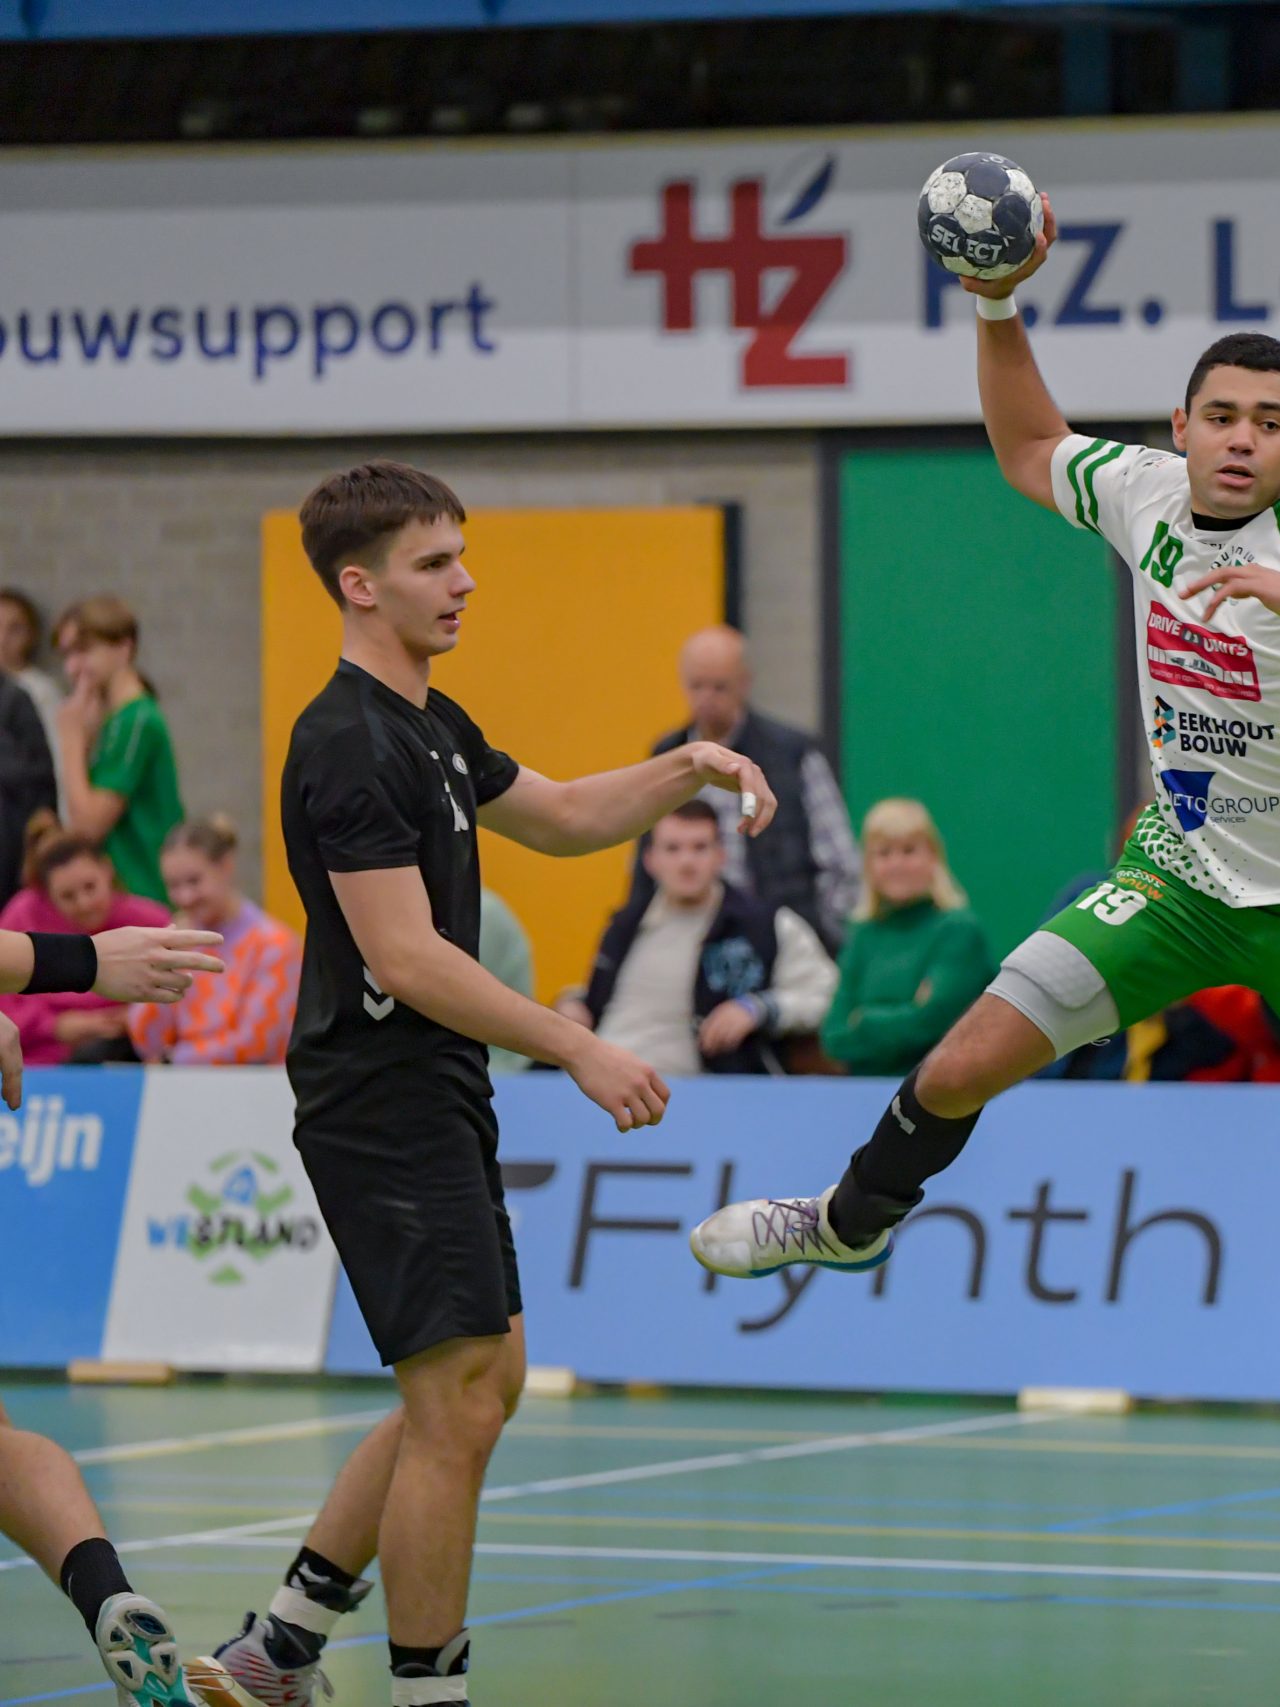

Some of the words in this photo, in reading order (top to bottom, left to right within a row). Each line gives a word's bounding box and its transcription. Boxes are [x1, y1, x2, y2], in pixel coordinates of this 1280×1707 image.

[930, 223, 1003, 262] SELECT
[0, 282, 497, 381] uwsupport
[1139, 520, 1184, 588] 19
[1148, 612, 1183, 636] DRIVE
[1178, 711, 1275, 740] EEKHOUT
[1179, 733, 1247, 758] BOUW
[1076, 882, 1148, 926] 19
